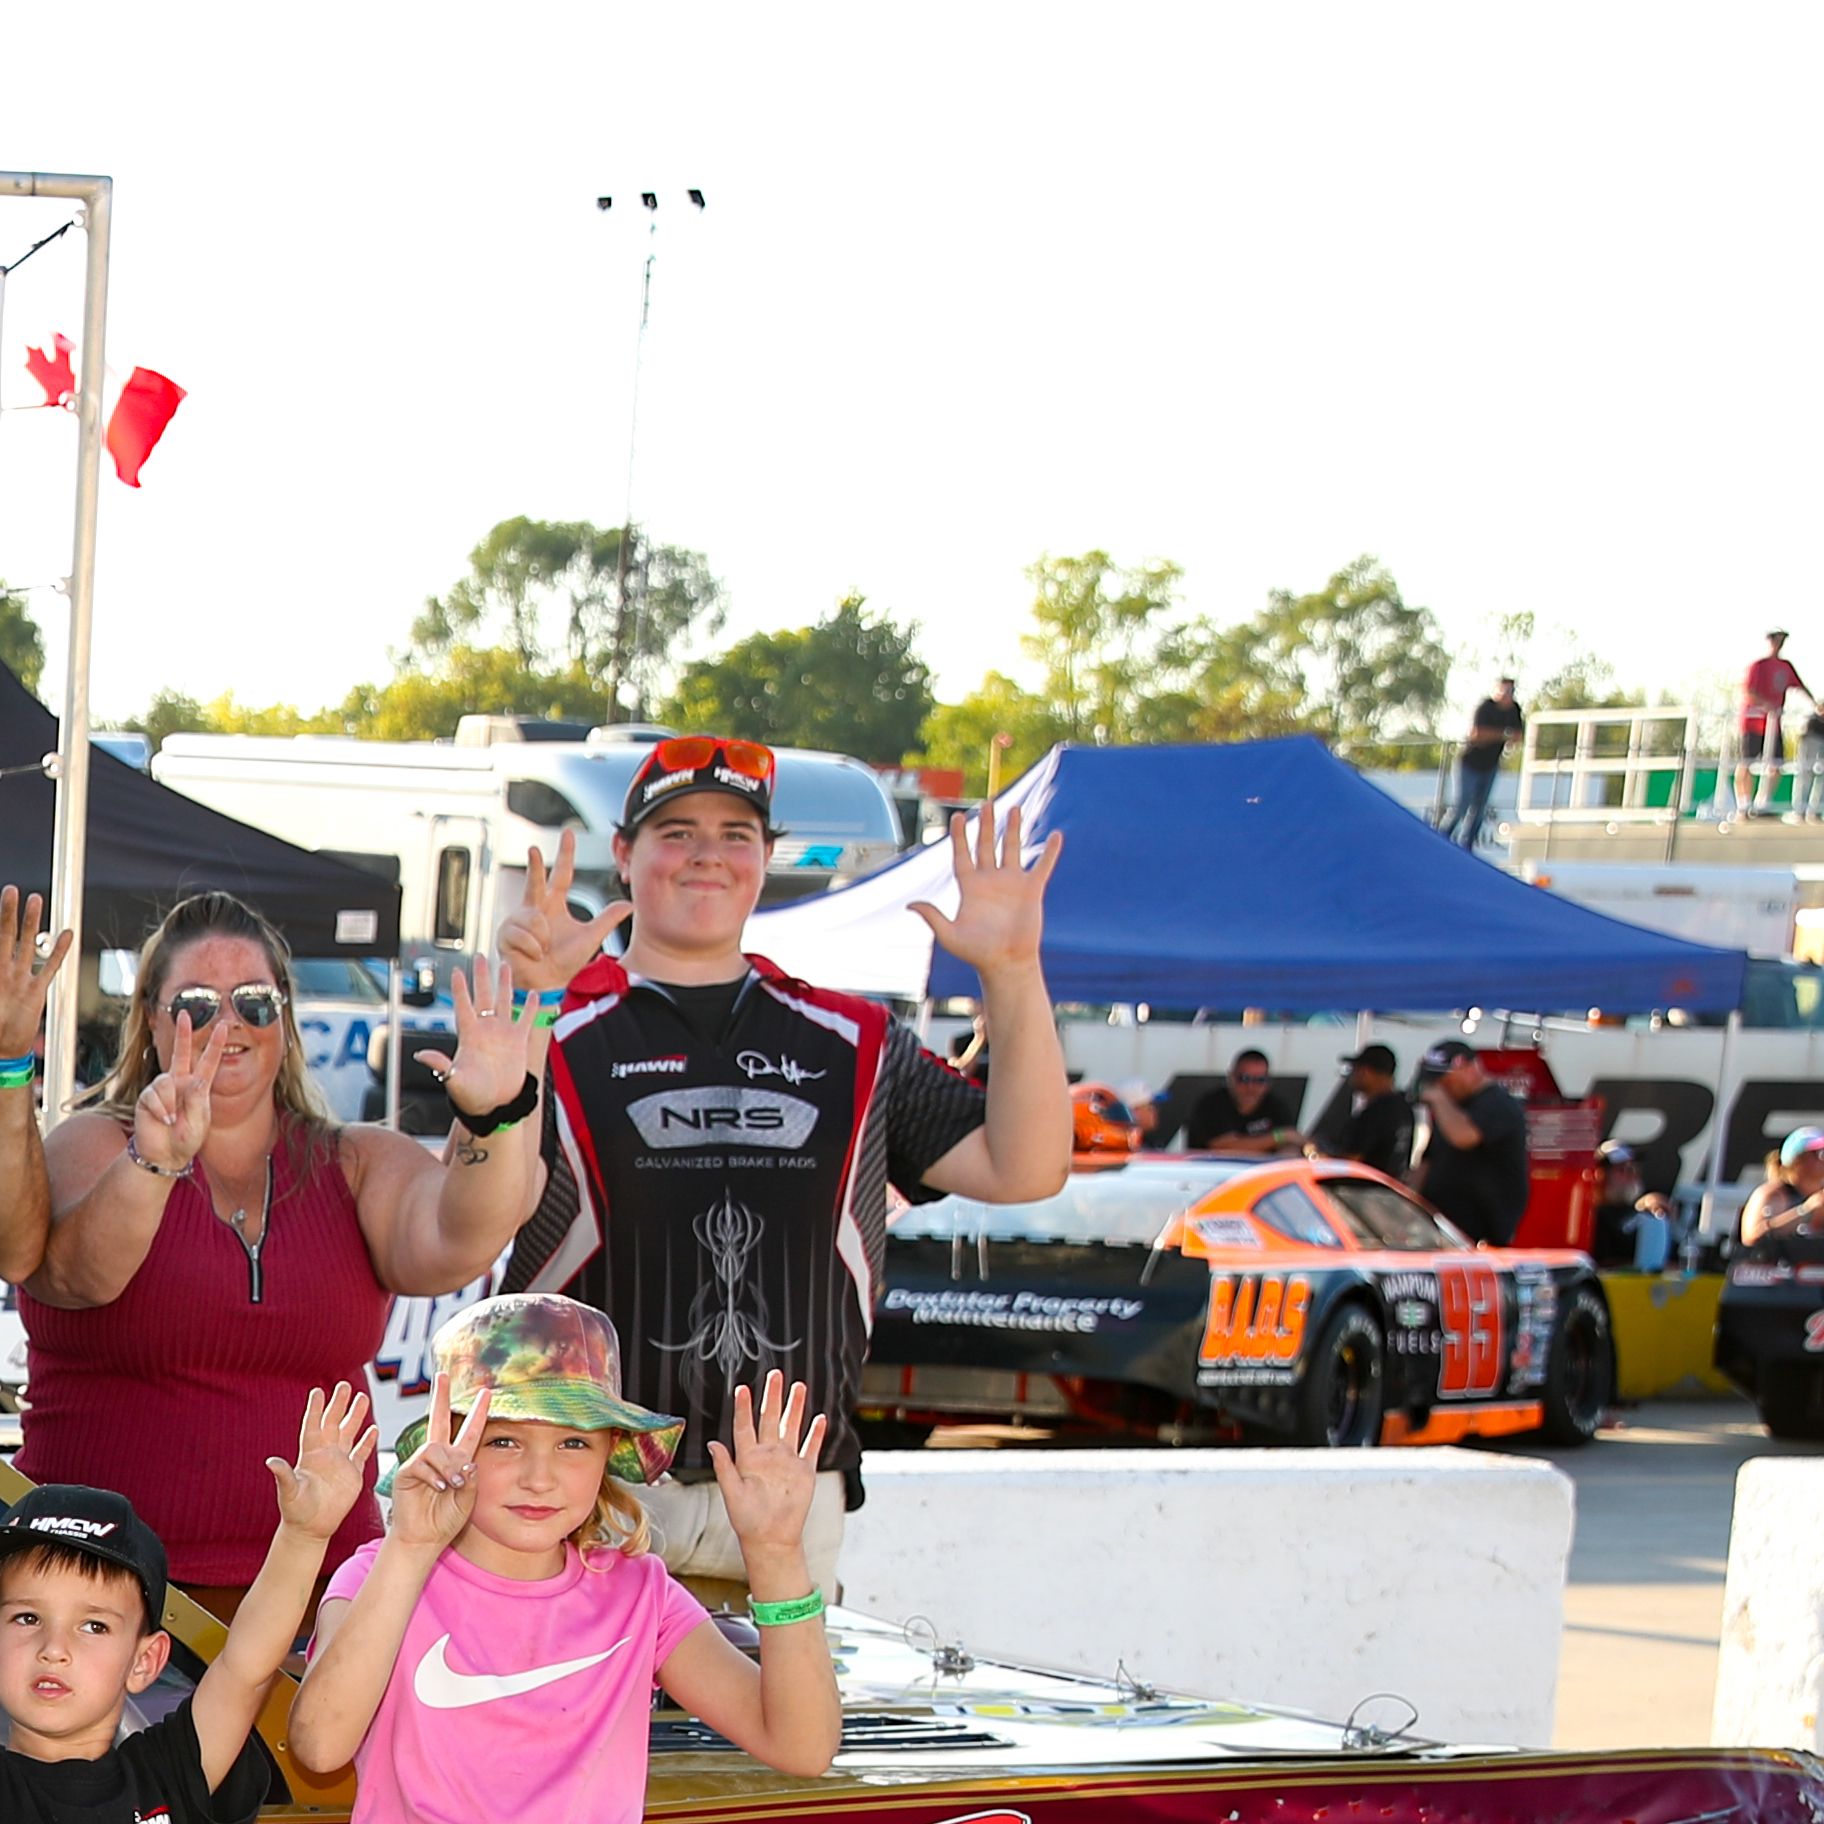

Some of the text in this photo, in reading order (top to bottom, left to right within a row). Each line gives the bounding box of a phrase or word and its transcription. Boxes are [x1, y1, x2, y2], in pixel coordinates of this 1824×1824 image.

[660, 1107, 784, 1130] NRS
[635, 1156, 817, 1169] GALVANIZED BRAKE PADS
[1381, 1273, 1438, 1301] WAMPUM
[1387, 1331, 1442, 1354] FUELS
[29, 1517, 115, 1537] HMCW
